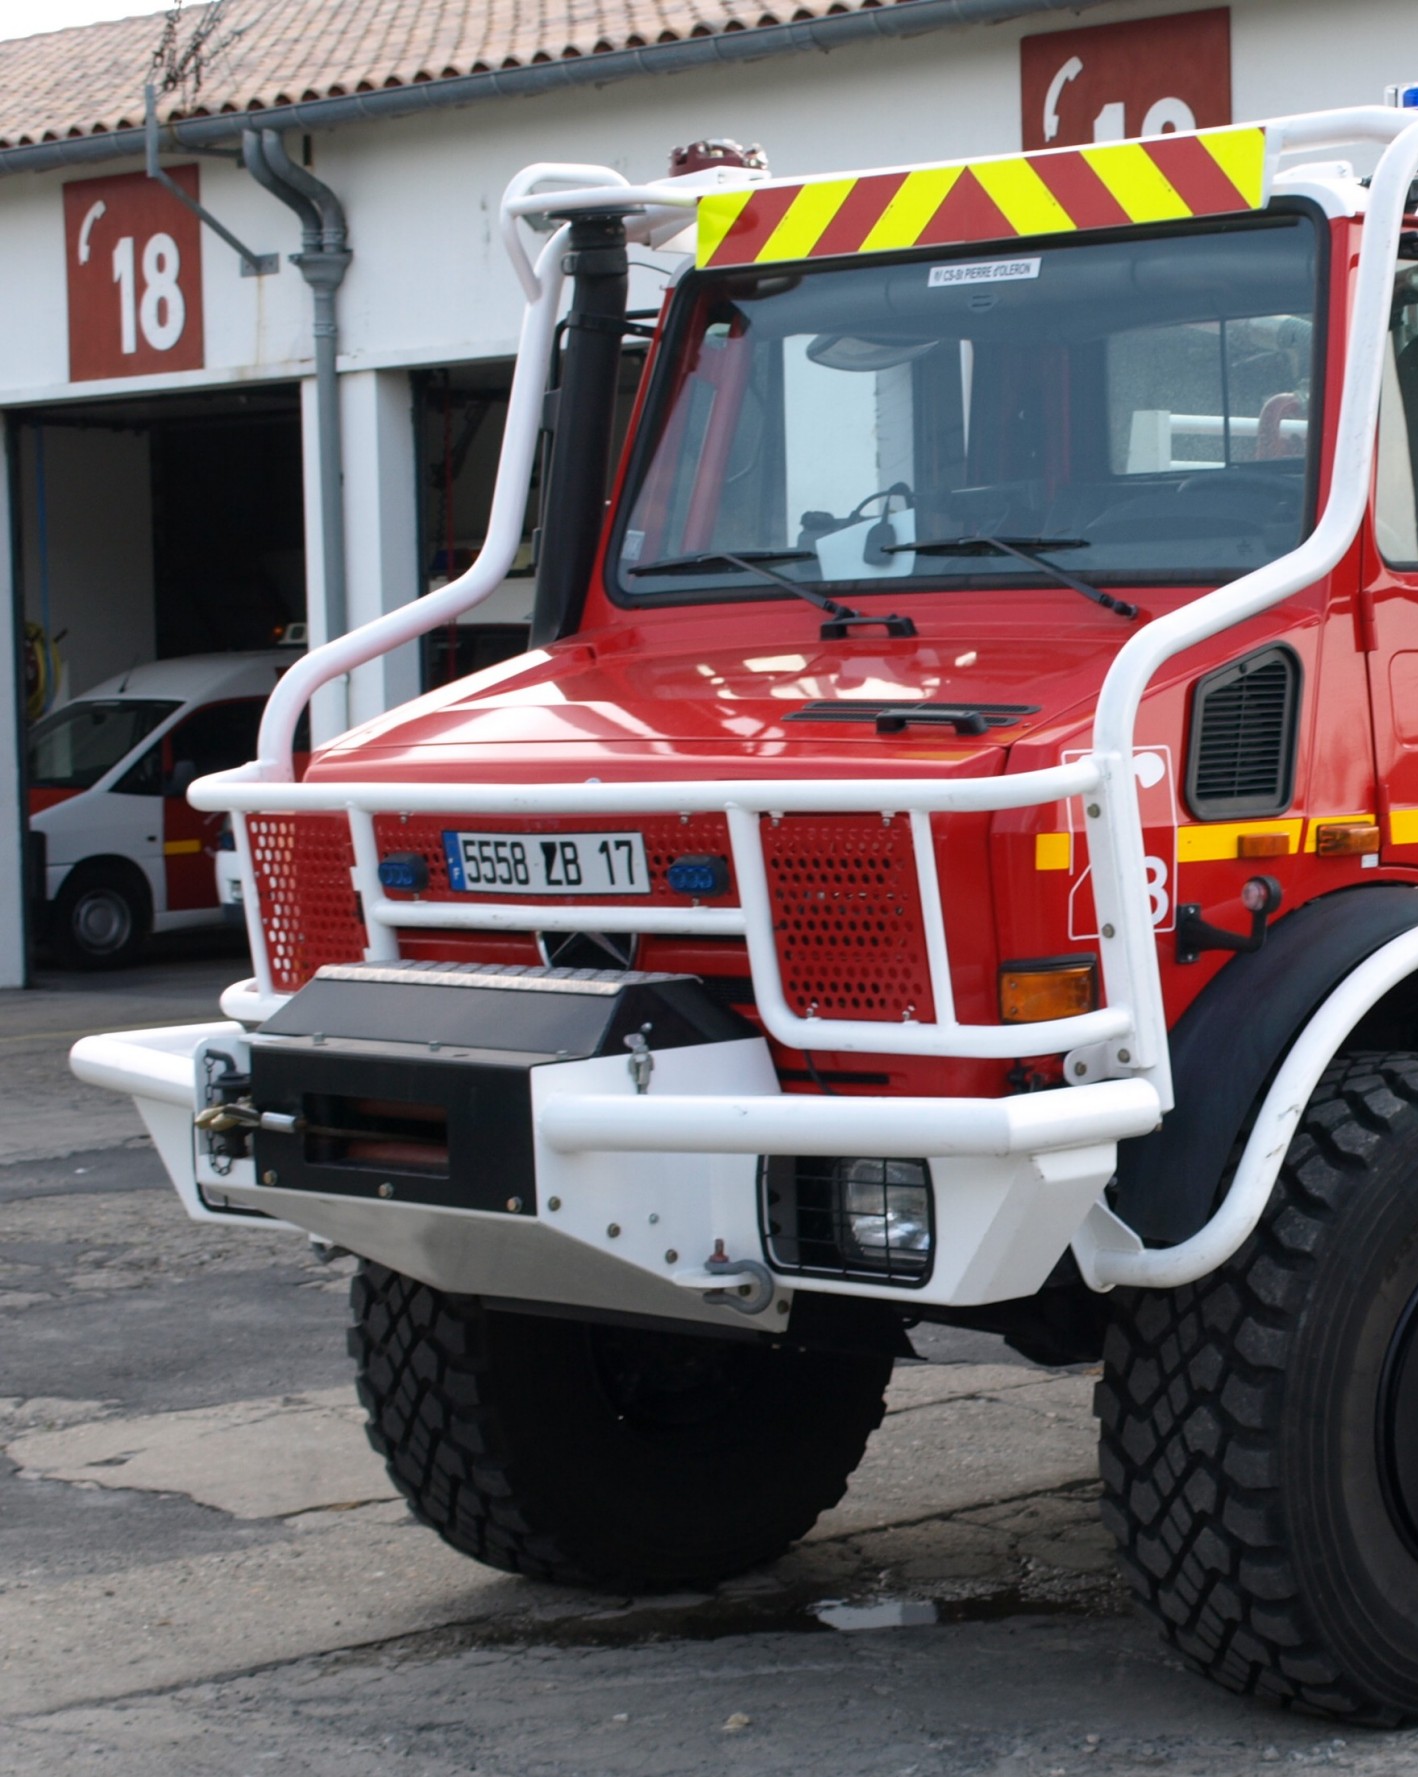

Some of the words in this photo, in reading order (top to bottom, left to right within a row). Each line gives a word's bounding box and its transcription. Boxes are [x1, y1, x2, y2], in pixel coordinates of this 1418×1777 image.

[112, 232, 186, 354] 18
[462, 839, 530, 886] 5558
[598, 839, 635, 886] 17
